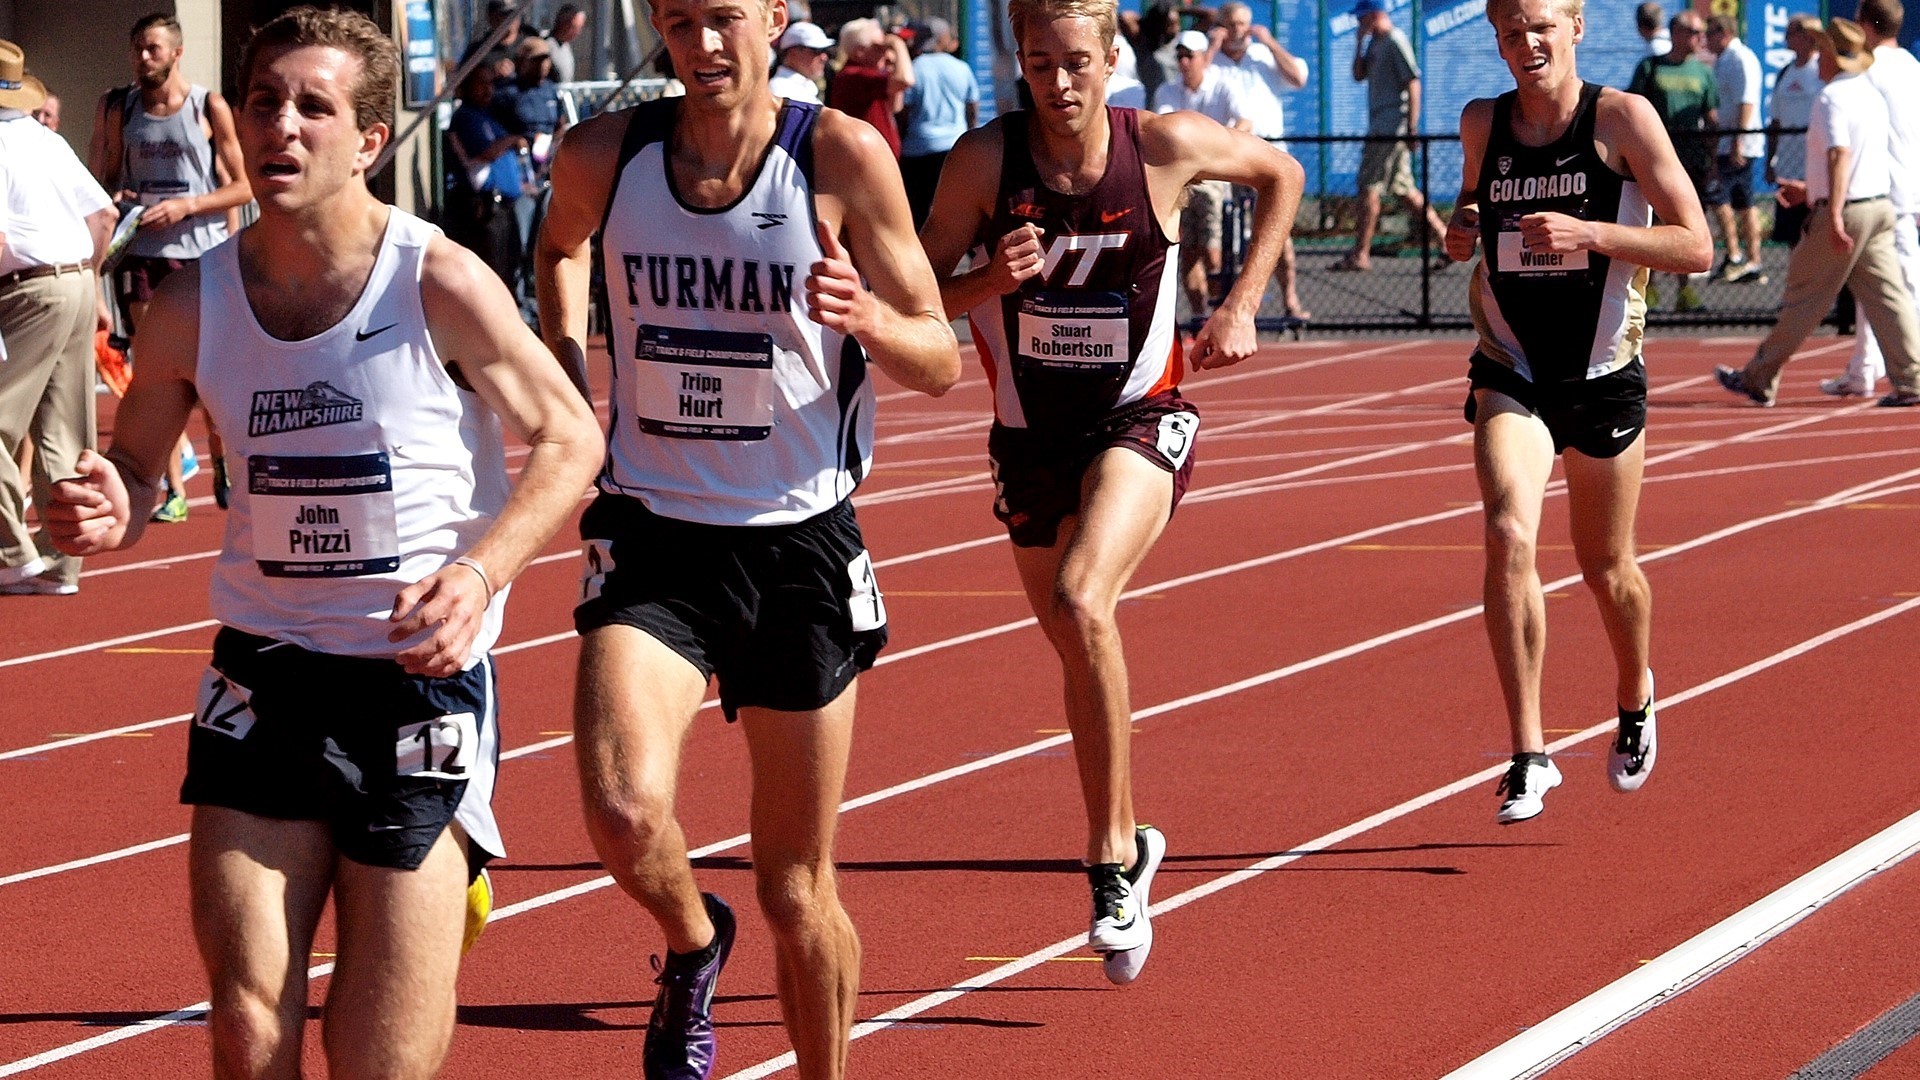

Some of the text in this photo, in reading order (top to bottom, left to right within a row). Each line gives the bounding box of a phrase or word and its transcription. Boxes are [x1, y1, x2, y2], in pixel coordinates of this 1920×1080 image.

[1489, 172, 1587, 202] COLORADO
[1519, 251, 1564, 266] Winter
[622, 252, 796, 314] FURMAN
[1051, 324, 1092, 338] Stuart
[656, 346, 679, 356] TRACK
[684, 348, 706, 358] FIELD
[706, 350, 769, 362] CHAMPIONSHIPS
[1031, 336, 1114, 357] Robertson
[680, 371, 722, 394] Tripp
[254, 392, 301, 412] NEW
[679, 394, 723, 419] Hurt
[251, 402, 363, 435] HAMPSHIRE
[268, 477, 290, 488] TRACK
[318, 474, 387, 488] CHAMPIONSHIPS
[295, 504, 340, 524] John
[289, 528, 351, 554] Prizzi
[202, 675, 250, 733] 12
[414, 721, 467, 775] 12
